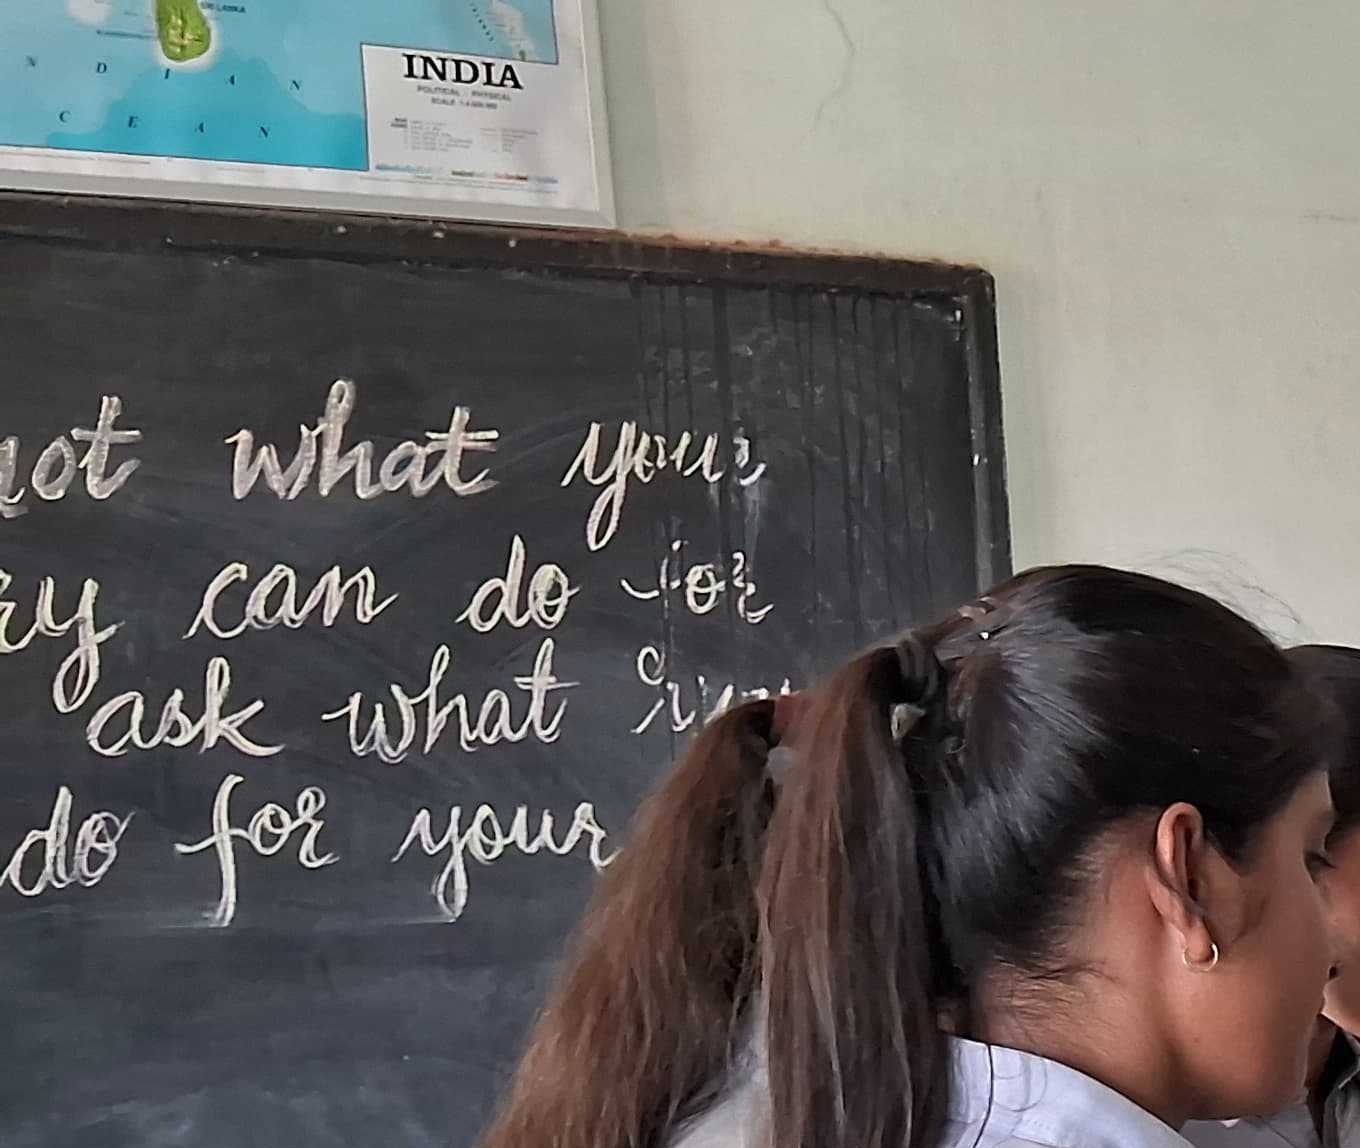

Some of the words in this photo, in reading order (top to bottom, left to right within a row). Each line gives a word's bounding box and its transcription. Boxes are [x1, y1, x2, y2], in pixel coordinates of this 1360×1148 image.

[402, 53, 524, 90] INDIA
[225, 378, 499, 501] what
[183, 562, 399, 639] can
[455, 535, 580, 632] do
[87, 656, 285, 756] ask
[322, 638, 580, 763] what
[0, 786, 135, 896] do
[175, 774, 340, 927] for
[392, 801, 622, 922] your
